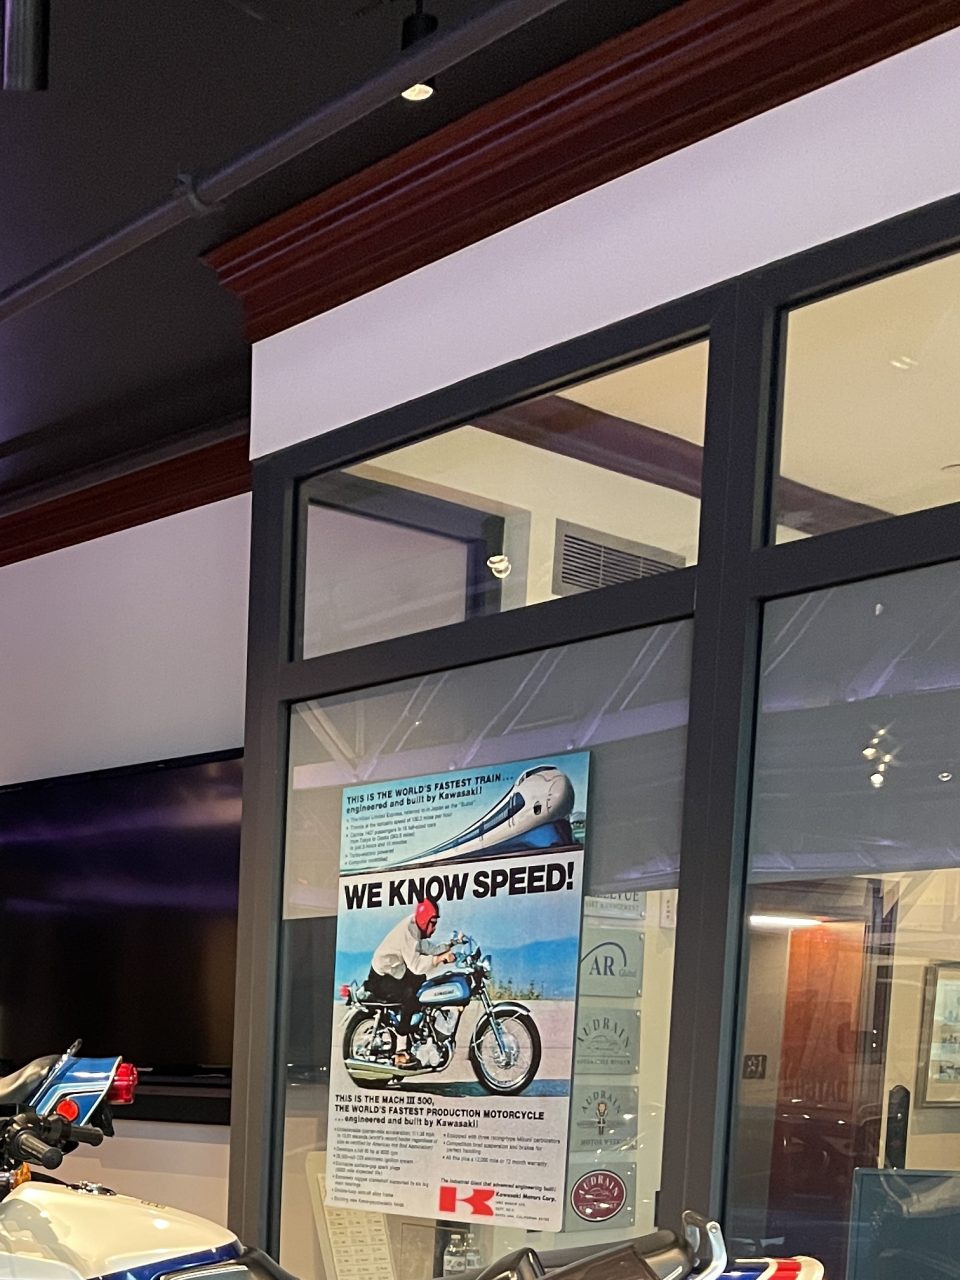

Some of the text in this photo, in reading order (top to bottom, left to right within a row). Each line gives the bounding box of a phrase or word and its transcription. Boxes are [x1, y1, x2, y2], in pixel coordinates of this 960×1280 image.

[347, 794, 365, 804] THIS
[367, 792, 375, 801] IS
[377, 790, 392, 800] THE
[395, 784, 432, 798] WORLD'S
[434, 778, 472, 792] FASTEST
[346, 803, 388, 815] engineered
[390, 798, 405, 808] and
[406, 795, 425, 806] built
[426, 793, 436, 803] by
[344, 861, 575, 910] WE KNOW SPEED!
[589, 955, 616, 977] AR
[576, 1016, 630, 1049] AUDRAIN
[335, 1094, 352, 1103] THIS
[354, 1094, 362, 1103] IS
[365, 1095, 380, 1104] THE
[382, 1096, 405, 1104] MACH
[581, 1090, 622, 1114] AUDRAIN
[335, 1104, 545, 1120] THE WORLD'S FASTEST PRODUCTION MOTORCYCLE
[387, 1117, 402, 1125] and
[404, 1116, 423, 1126] built
[424, 1118, 433, 1127] by
[579, 1175, 619, 1198] AUDRAIN
